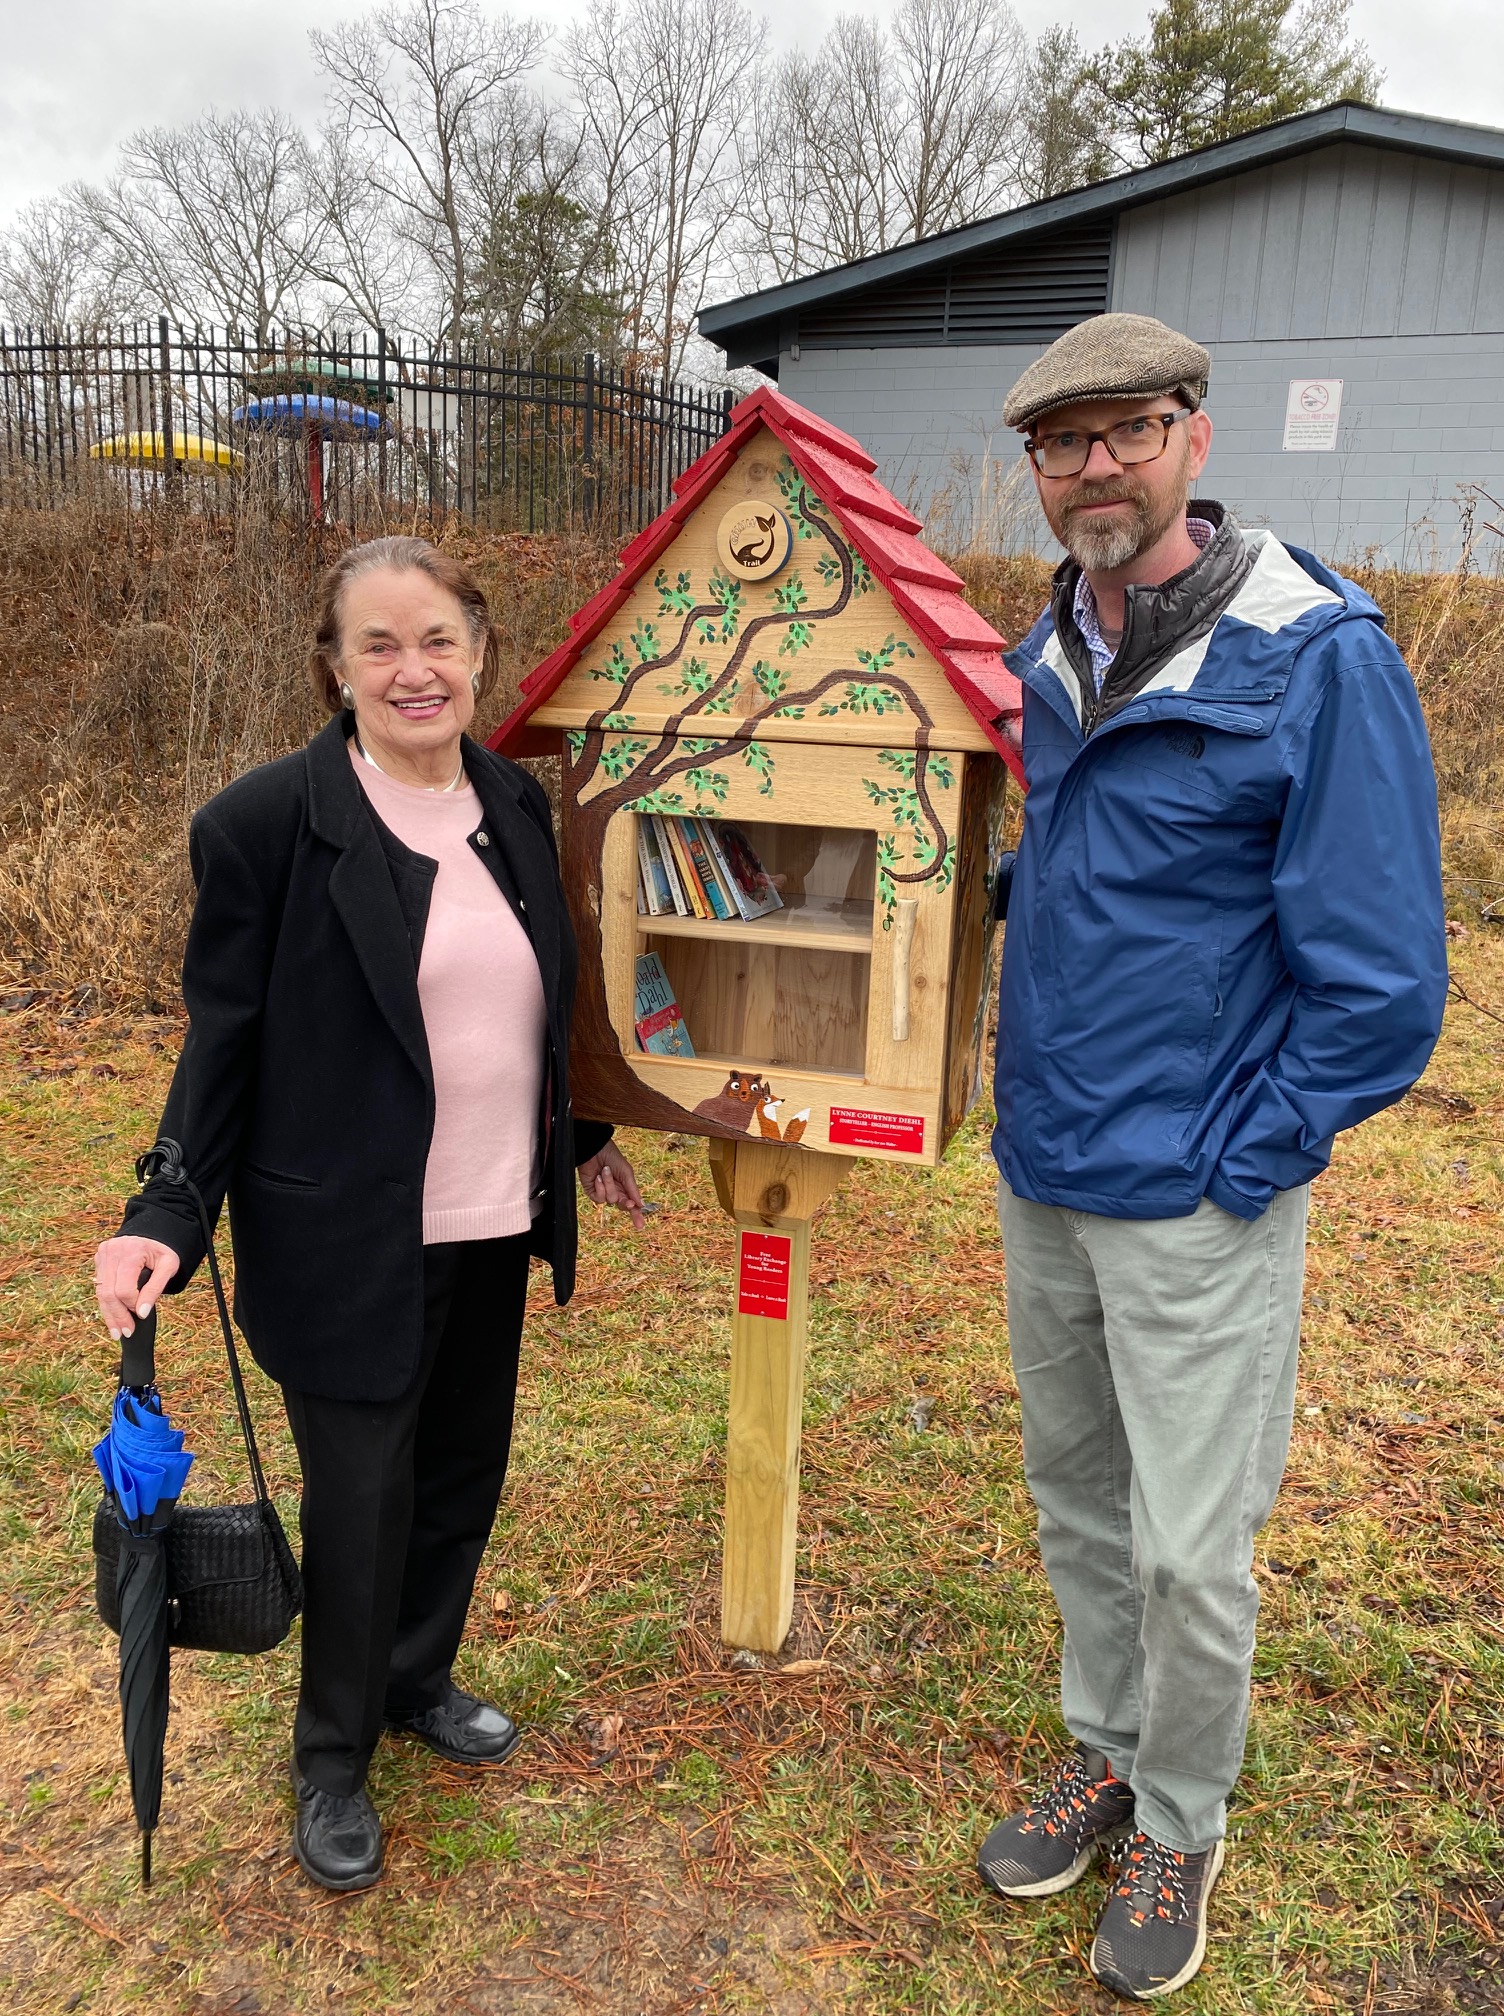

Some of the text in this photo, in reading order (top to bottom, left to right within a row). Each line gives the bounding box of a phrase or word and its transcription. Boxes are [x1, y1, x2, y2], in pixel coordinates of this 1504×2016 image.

[638, 982, 668, 1014] Dahl
[857, 1113, 897, 1122] COURTNEY
[763, 1257, 787, 1265] Exchange
